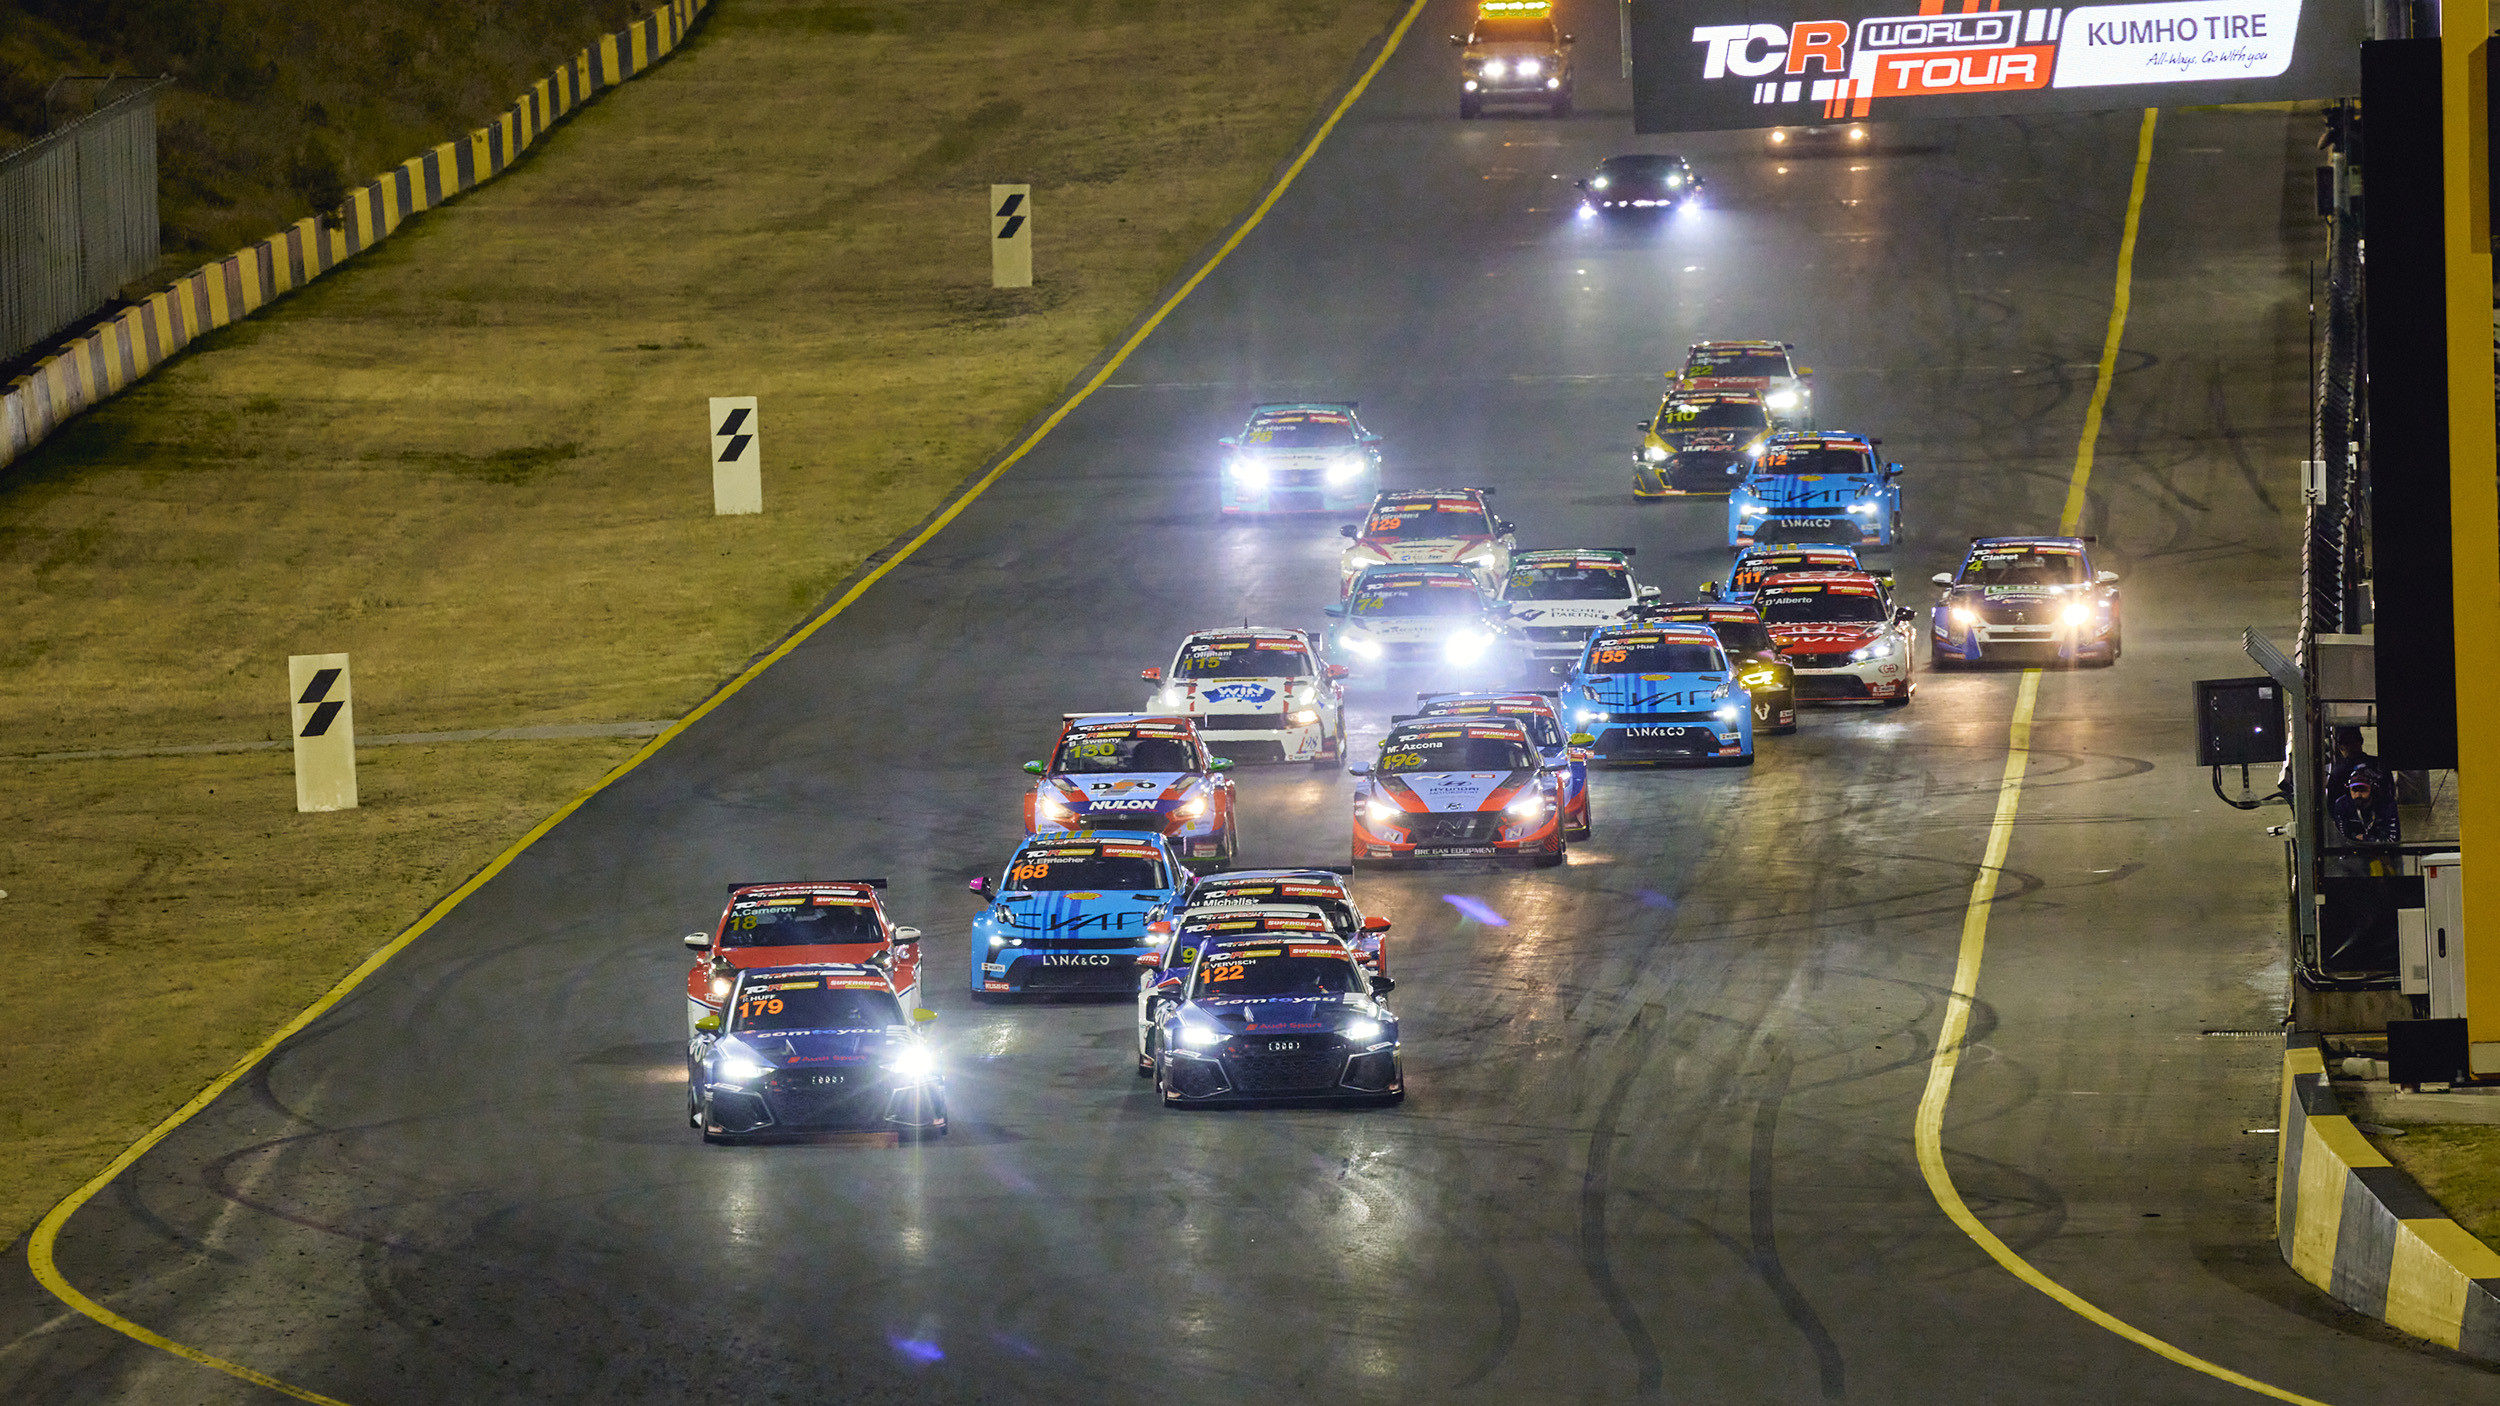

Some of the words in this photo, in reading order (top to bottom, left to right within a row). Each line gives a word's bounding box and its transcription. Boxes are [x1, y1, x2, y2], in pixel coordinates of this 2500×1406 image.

[1867, 18, 2004, 48] WORLD
[2087, 18, 2199, 47] KUMHO
[2202, 14, 2268, 41] TIRE
[1692, 20, 1850, 80] TCR
[2245, 52, 2268, 69] you
[1886, 48, 2038, 90] TOUR
[1688, 365, 1714, 378] 22
[1664, 409, 1697, 424] 110
[1249, 431, 1273, 444] 76
[1757, 455, 1788, 467] 112
[1369, 517, 1402, 532] 129
[1981, 553, 2019, 561] Clairet
[1967, 560, 1983, 571] 4
[1510, 575, 1534, 588] 33
[1735, 571, 1761, 586] 111
[1357, 597, 1384, 611] 74
[1765, 597, 1812, 606] D'Alberto
[1183, 657, 1220, 671] 115
[1590, 650, 1627, 665] 155
[1217, 687, 1265, 695] WIN
[1069, 742, 1116, 759] 130
[1401, 741, 1443, 751] Azcona
[1382, 752, 1421, 770] 196
[1088, 800, 1158, 811] NULON
[1011, 863, 1049, 881] 168
[1284, 886, 1339, 895] SUPERCHEAP
[730, 915, 757, 931] 18
[1267, 920, 1322, 928] SUPERCHEAP
[1292, 948, 1347, 956] SUPERCHEAP
[1210, 960, 1256, 969] VERVISCH
[1200, 965, 1245, 984] 122
[738, 997, 784, 1019] 179
[1214, 997, 1337, 1006] comtoyou
[1289, 1022, 1322, 1030] Sport
[757, 1028, 881, 1038] comtoyou
